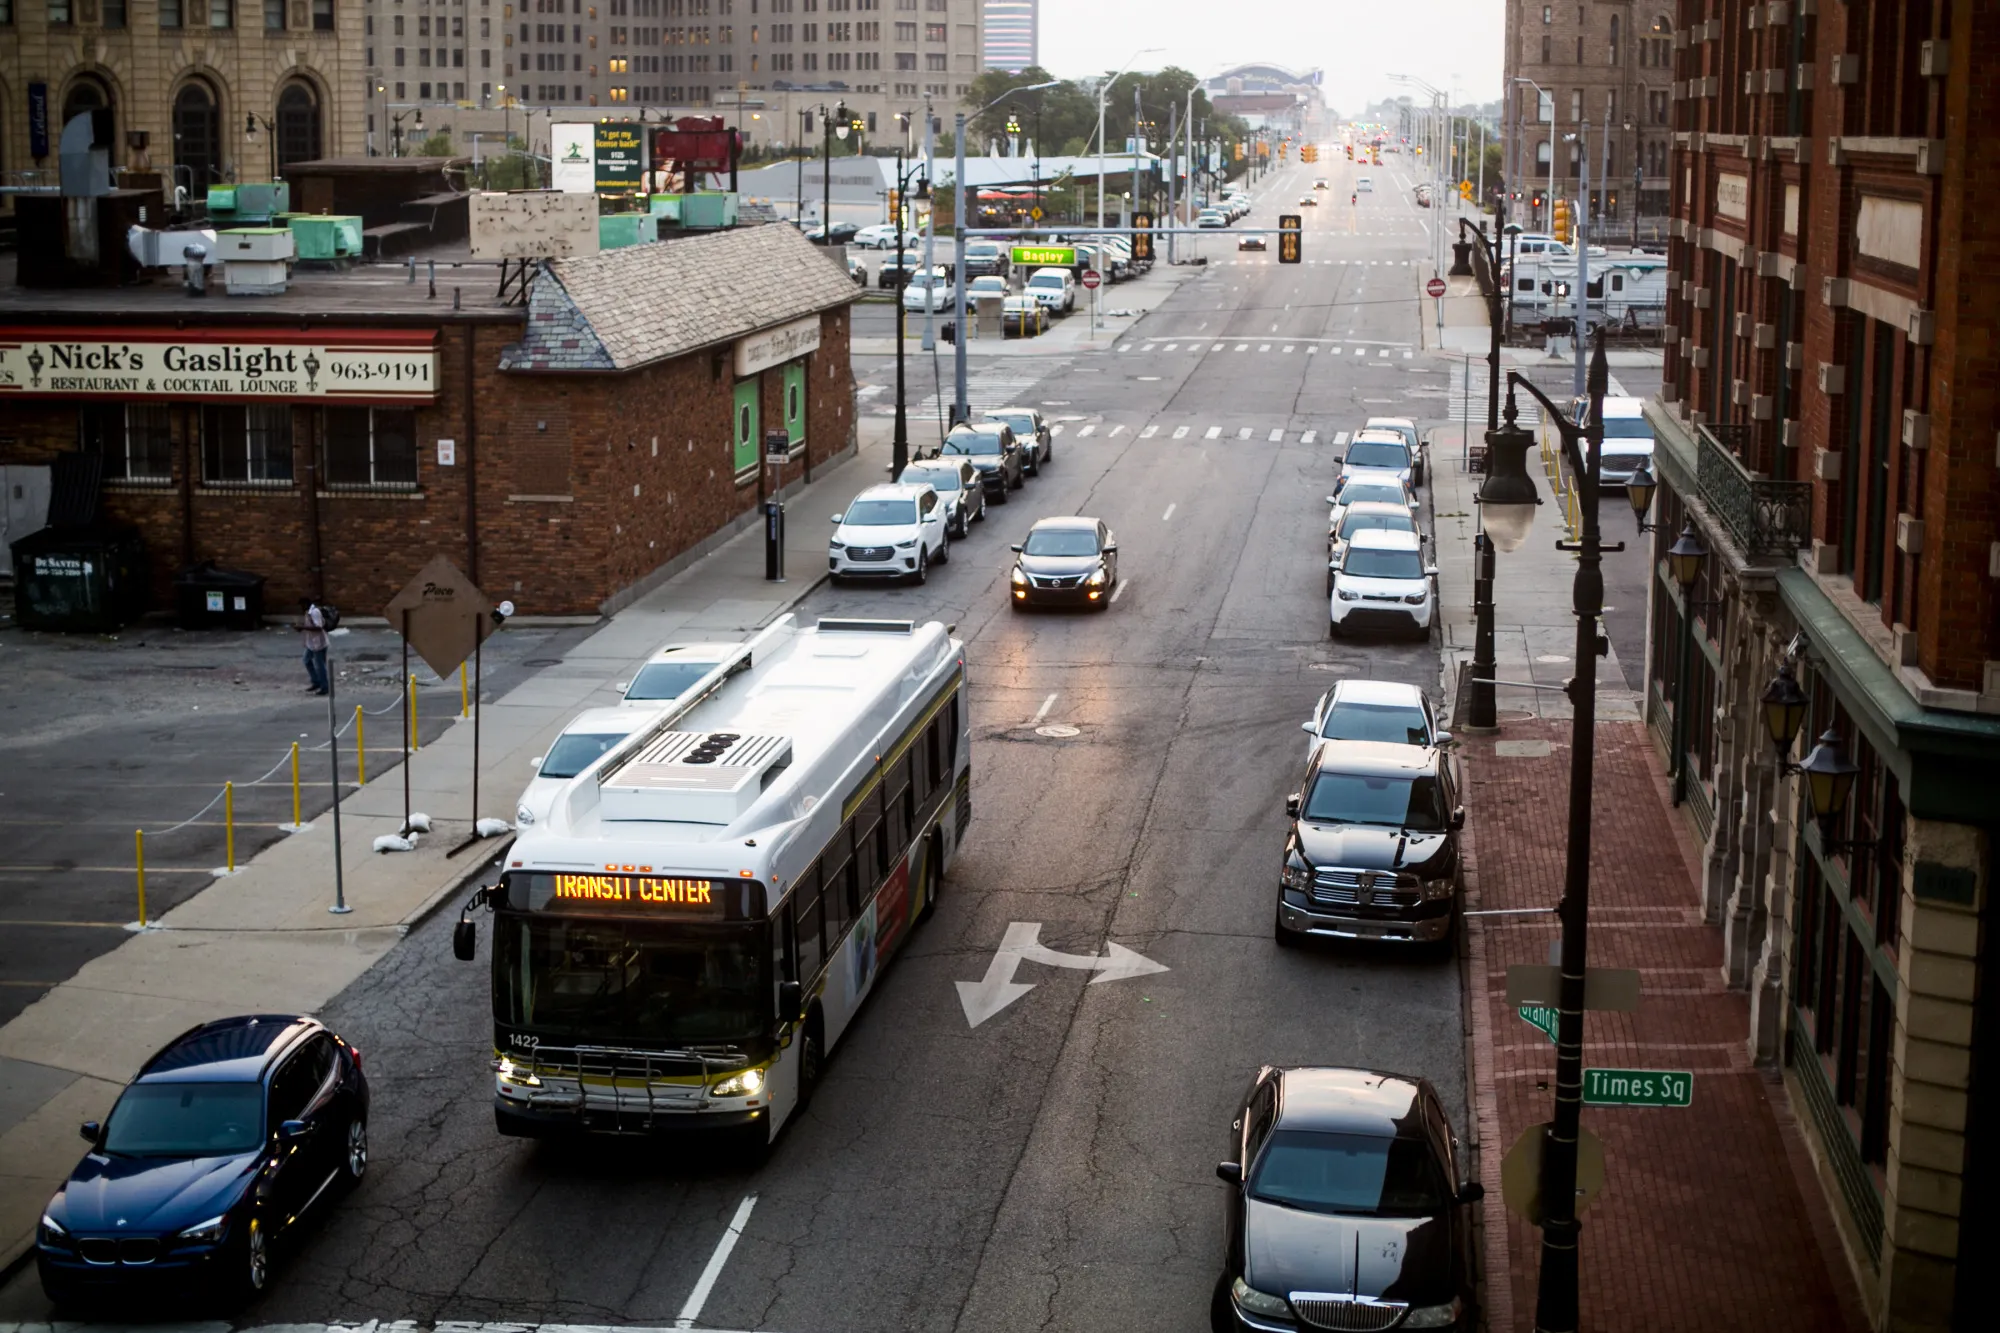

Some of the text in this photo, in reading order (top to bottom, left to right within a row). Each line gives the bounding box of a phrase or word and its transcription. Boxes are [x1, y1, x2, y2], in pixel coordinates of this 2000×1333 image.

[608, 131, 620, 140] got
[621, 131, 632, 140] my
[1022, 250, 1064, 263] Bagley
[49, 344, 298, 378] Nick's Gaslight
[330, 361, 429, 381] 963-9191
[50, 376, 298, 393] RESTAURANT & COCKTAIL LOUNGE
[555, 874, 711, 903] TRANSIT CENTER
[508, 1033, 540, 1048] 1422
[1591, 1072, 1685, 1102] Times Sq
